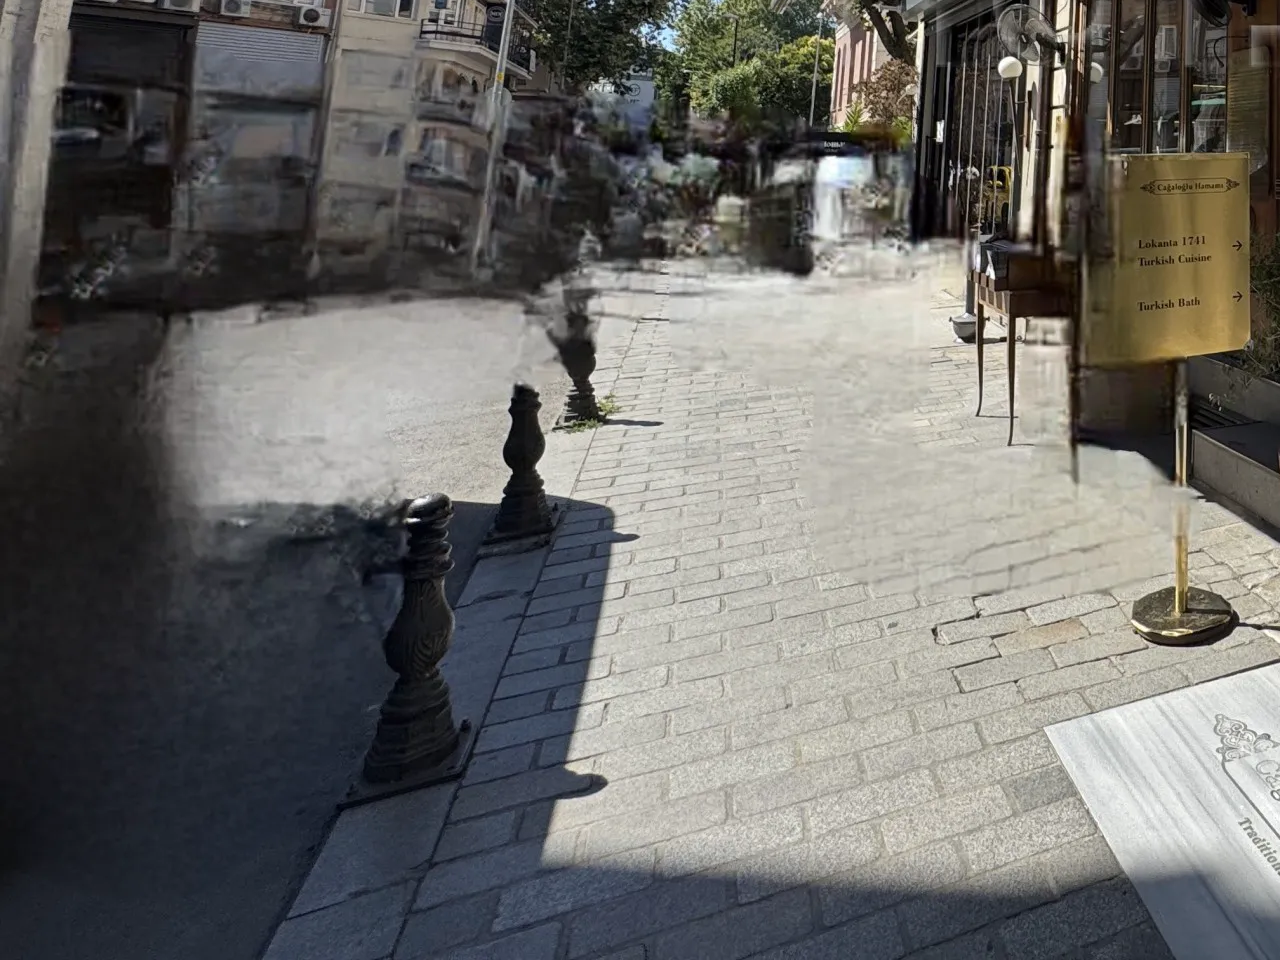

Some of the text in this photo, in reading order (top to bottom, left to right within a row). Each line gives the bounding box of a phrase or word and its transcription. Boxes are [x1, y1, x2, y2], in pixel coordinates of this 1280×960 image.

[1139, 235, 1206, 249] Lokanta 1741
[1138, 254, 1212, 266] Turkish Cuisine
[1138, 297, 1200, 311] Turkish Bath
